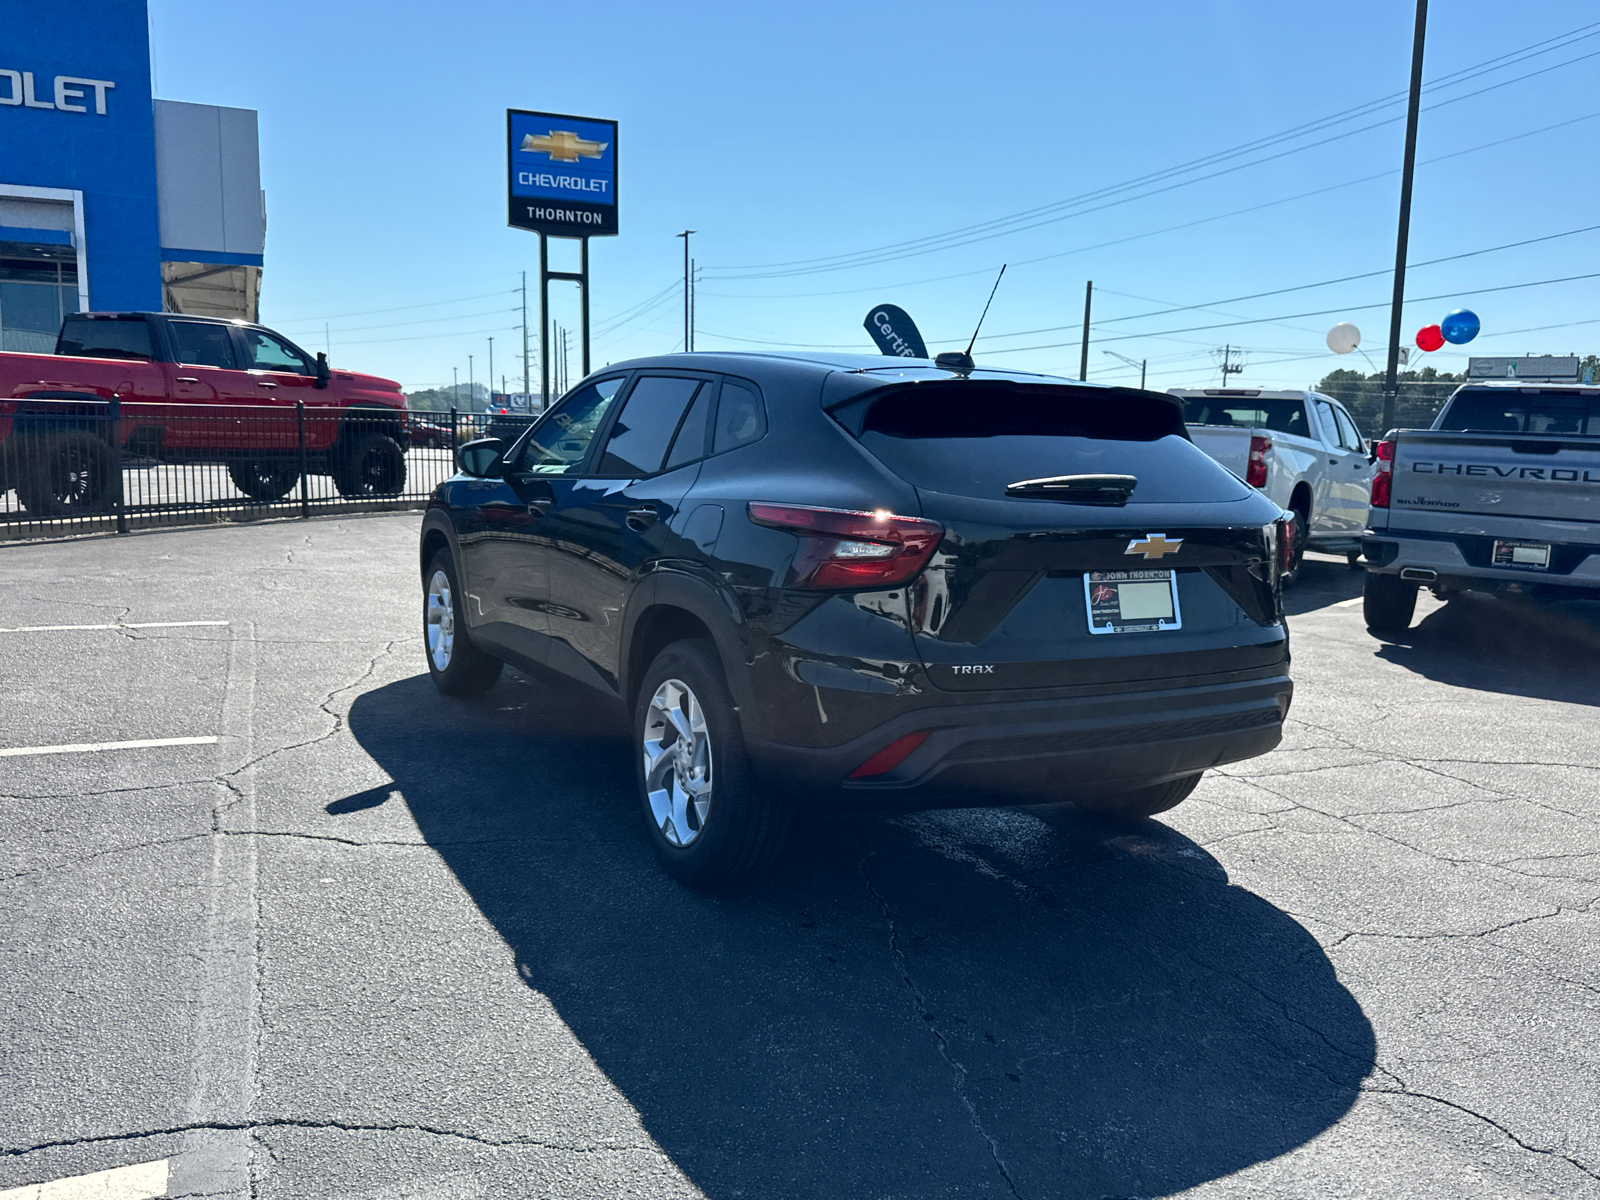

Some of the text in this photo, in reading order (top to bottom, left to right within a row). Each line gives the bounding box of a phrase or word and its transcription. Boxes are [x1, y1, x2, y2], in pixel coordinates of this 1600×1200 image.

[518, 171, 609, 193] CHEVROLET
[526, 206, 603, 225] THORNTON
[873, 311, 915, 358] Certif
[1396, 498, 1461, 508] SILVERADO
[1106, 570, 1171, 580] JOHN THORNTON
[951, 664, 994, 674] TRAX
